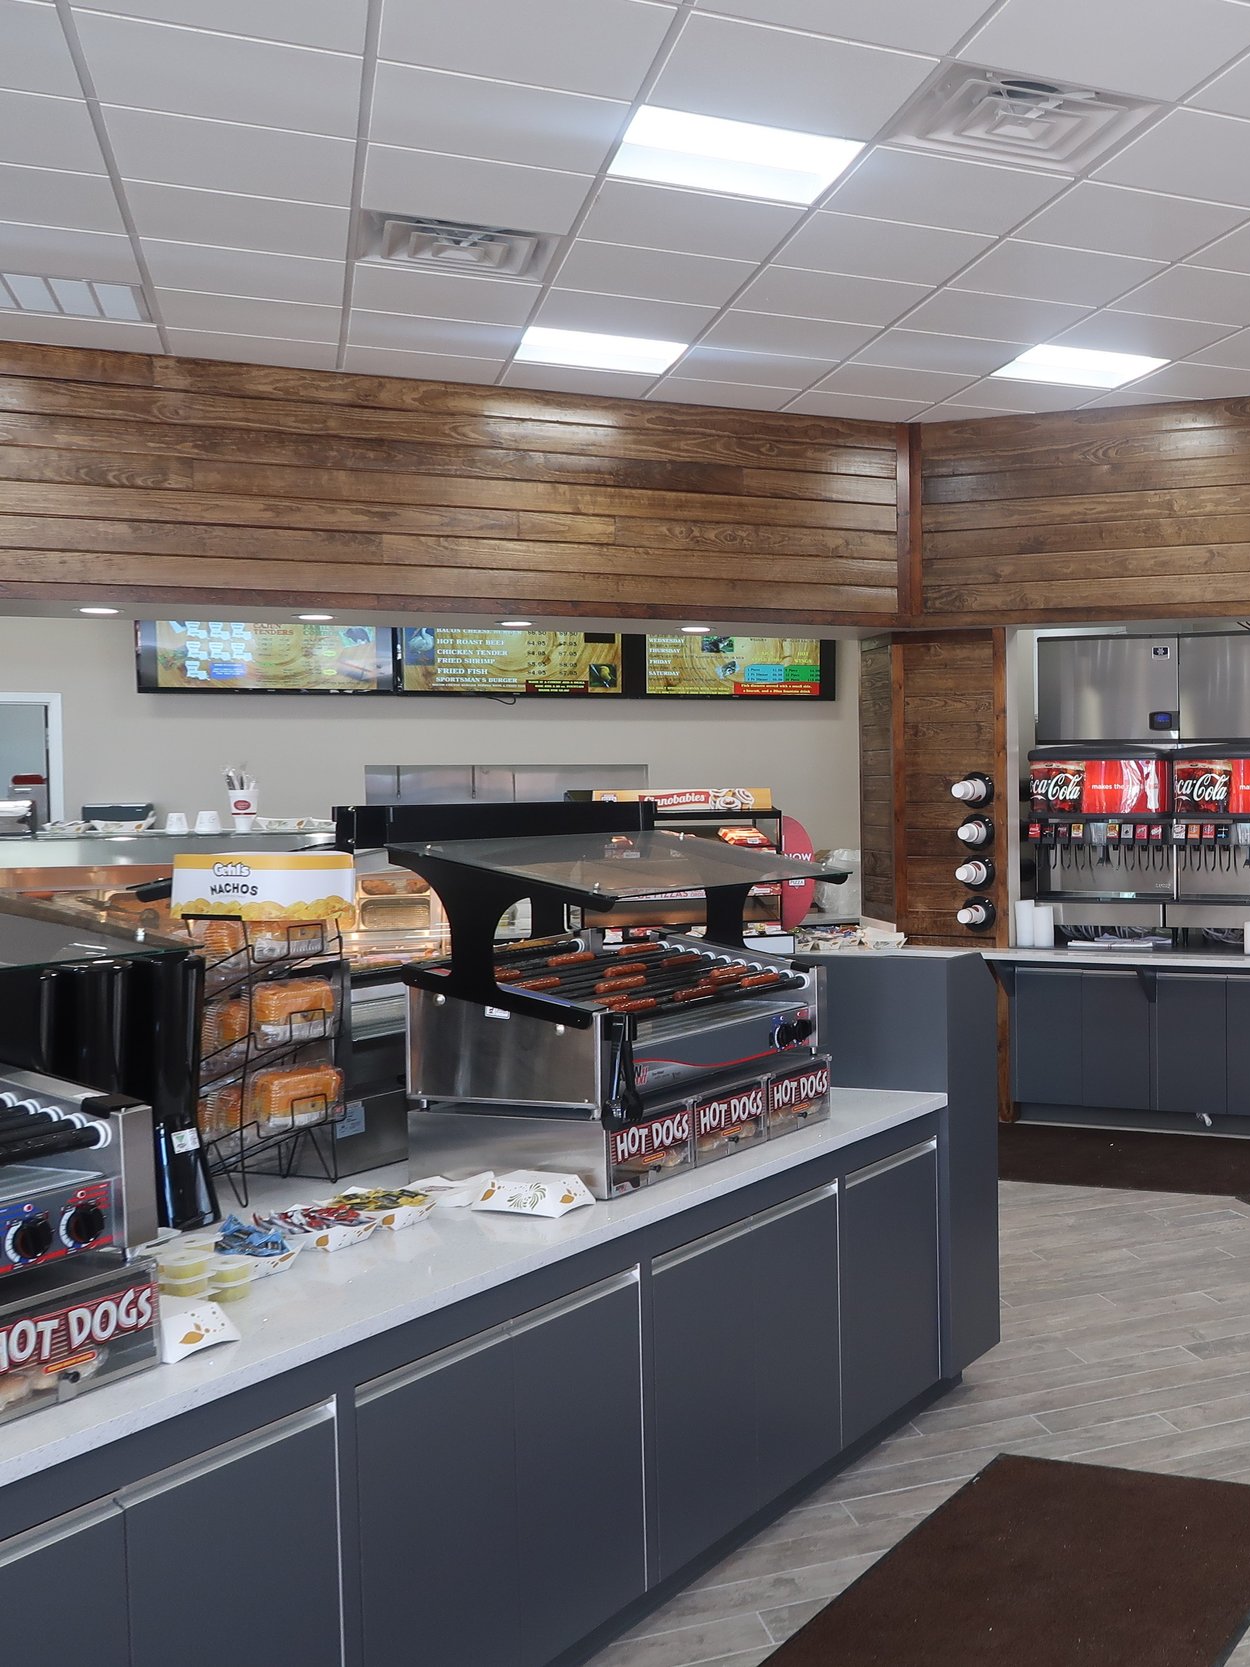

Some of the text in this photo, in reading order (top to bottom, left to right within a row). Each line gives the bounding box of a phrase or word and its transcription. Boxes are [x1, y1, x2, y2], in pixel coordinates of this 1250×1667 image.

[210, 883, 259, 896] NACHOS
[773, 1069, 828, 1109] HOT DOGS
[699, 1090, 763, 1135] HOT DOGS
[616, 1112, 689, 1162] HOT DOGS
[68, 1287, 152, 1350] DOGS
